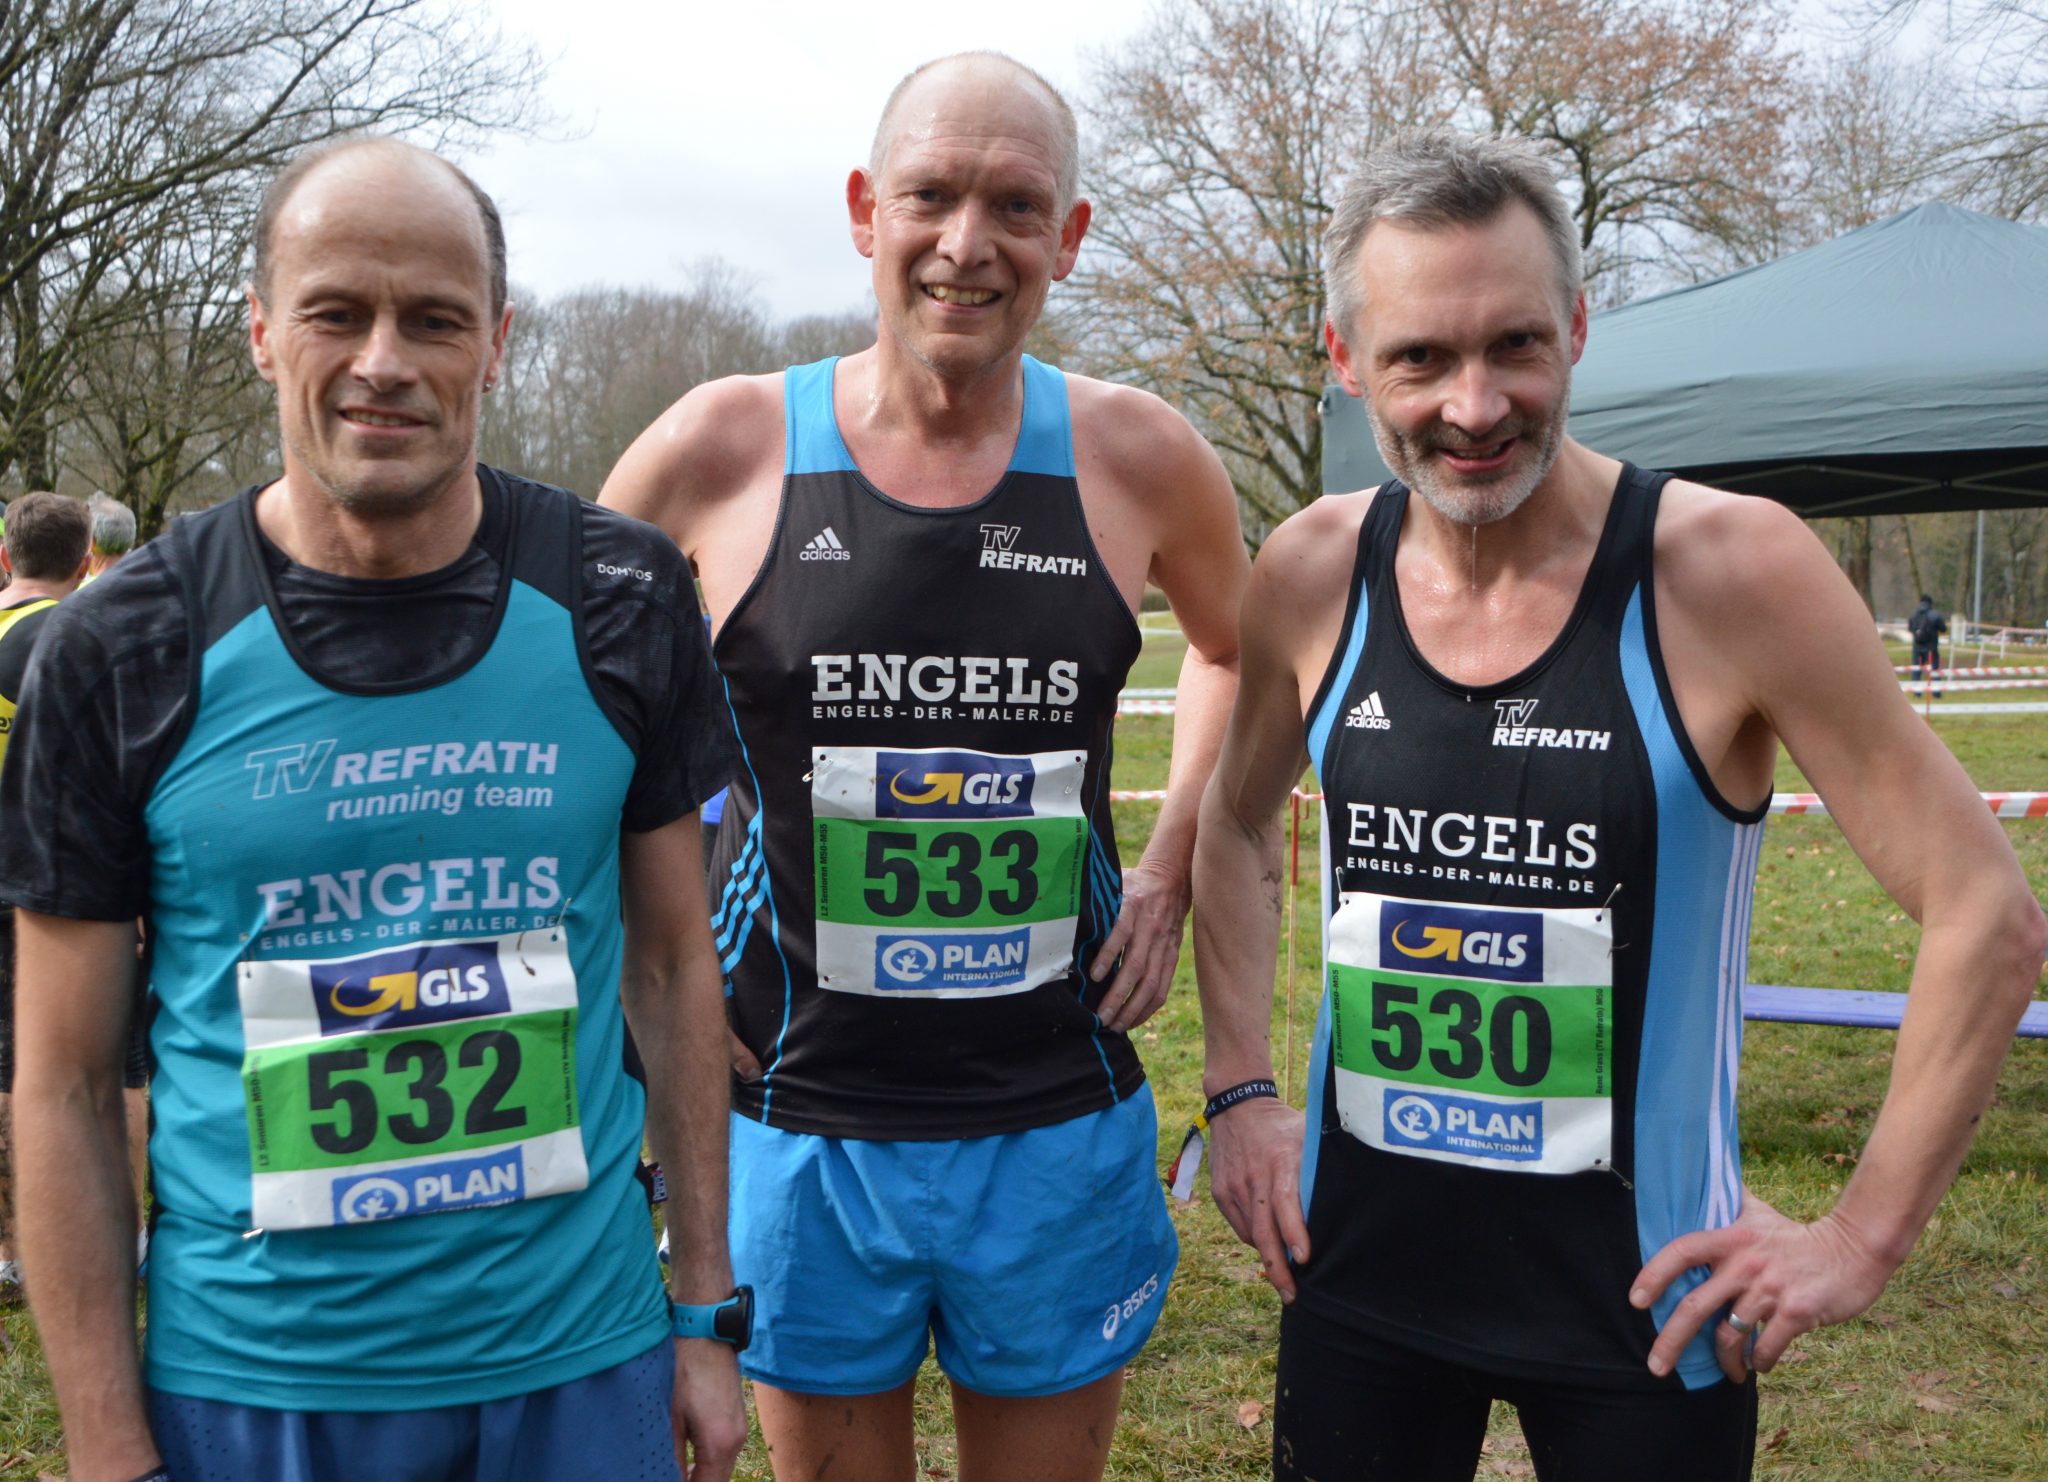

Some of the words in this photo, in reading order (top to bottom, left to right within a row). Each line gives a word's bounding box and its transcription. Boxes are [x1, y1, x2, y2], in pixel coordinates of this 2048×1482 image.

[800, 547, 850, 561] adidas
[980, 524, 1021, 551] TV
[597, 563, 653, 581] DOMYOS
[979, 550, 1087, 576] REFRATH
[811, 654, 1079, 706] ENGELS
[813, 705, 1074, 723] ENGELS-DER-MALER.DE
[1345, 714, 1391, 730] adidas
[1495, 699, 1539, 727] TV
[1492, 727, 1611, 751] REFRATH
[244, 739, 338, 800] TV
[330, 741, 559, 788] REFRATH
[326, 785, 464, 822] running
[474, 781, 553, 808] team
[963, 773, 1023, 805] GLS
[1347, 802, 1597, 870] ENGELS
[863, 829, 1039, 918] 533
[1346, 857, 1595, 893] ENGELS-DER-MALER.DE
[257, 856, 561, 931] ENGELS
[942, 941, 1024, 969] PLAN
[1462, 930, 1528, 968] GLS
[418, 964, 490, 1007] GLS
[943, 968, 1021, 981] INTERNATIONAL
[1371, 981, 1552, 1087] 530
[308, 1030, 528, 1155] 532
[1220, 1083, 1277, 1105] LEICHTATH
[1446, 1107, 1535, 1140] PLAN
[1446, 1136, 1535, 1154] INTERNATIONAL
[414, 1162, 518, 1207] PLAN
[1123, 1273, 1158, 1319] asics
